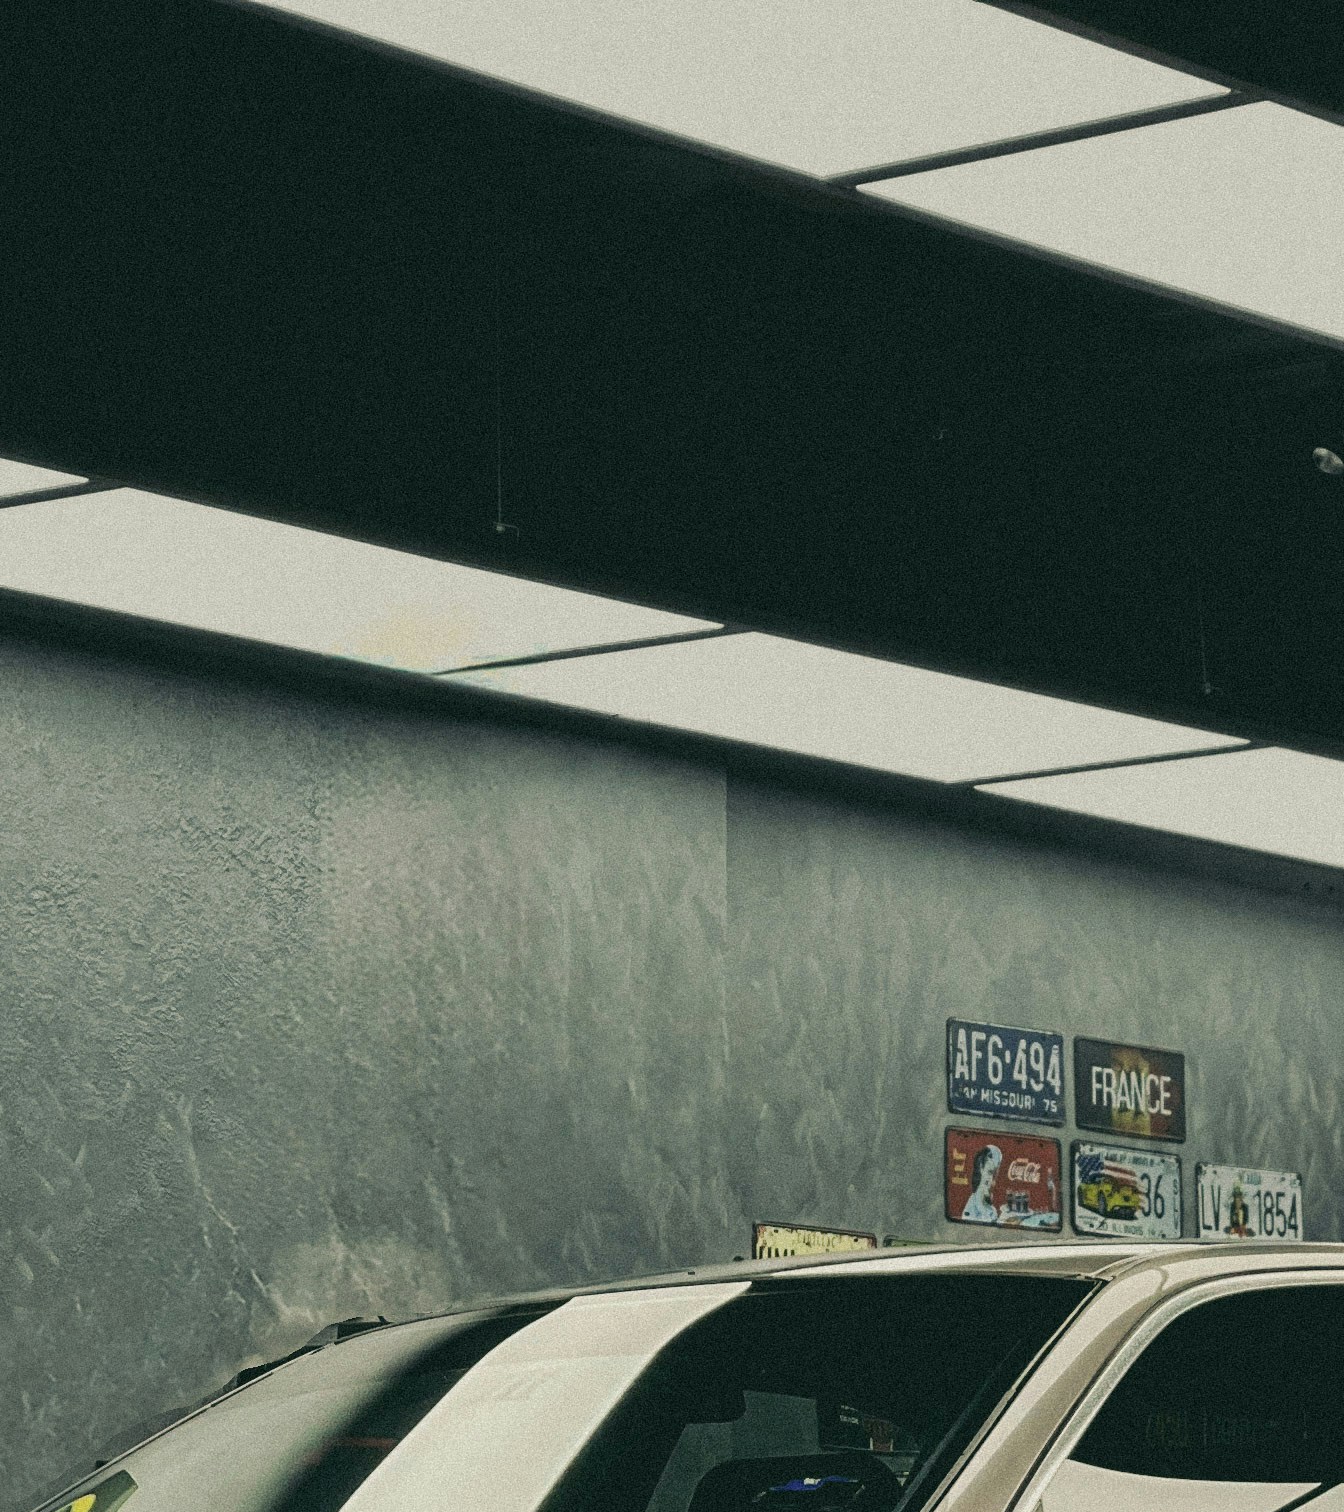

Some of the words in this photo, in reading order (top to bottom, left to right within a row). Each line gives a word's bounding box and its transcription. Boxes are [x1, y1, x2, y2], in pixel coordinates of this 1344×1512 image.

[980, 1087, 1037, 1111] MISSOURI
[1042, 1098, 1058, 1113] 75
[1091, 1065, 1173, 1117] FRANCE
[1200, 1183, 1222, 1232] LV
[1253, 1189, 1299, 1239] 1854
